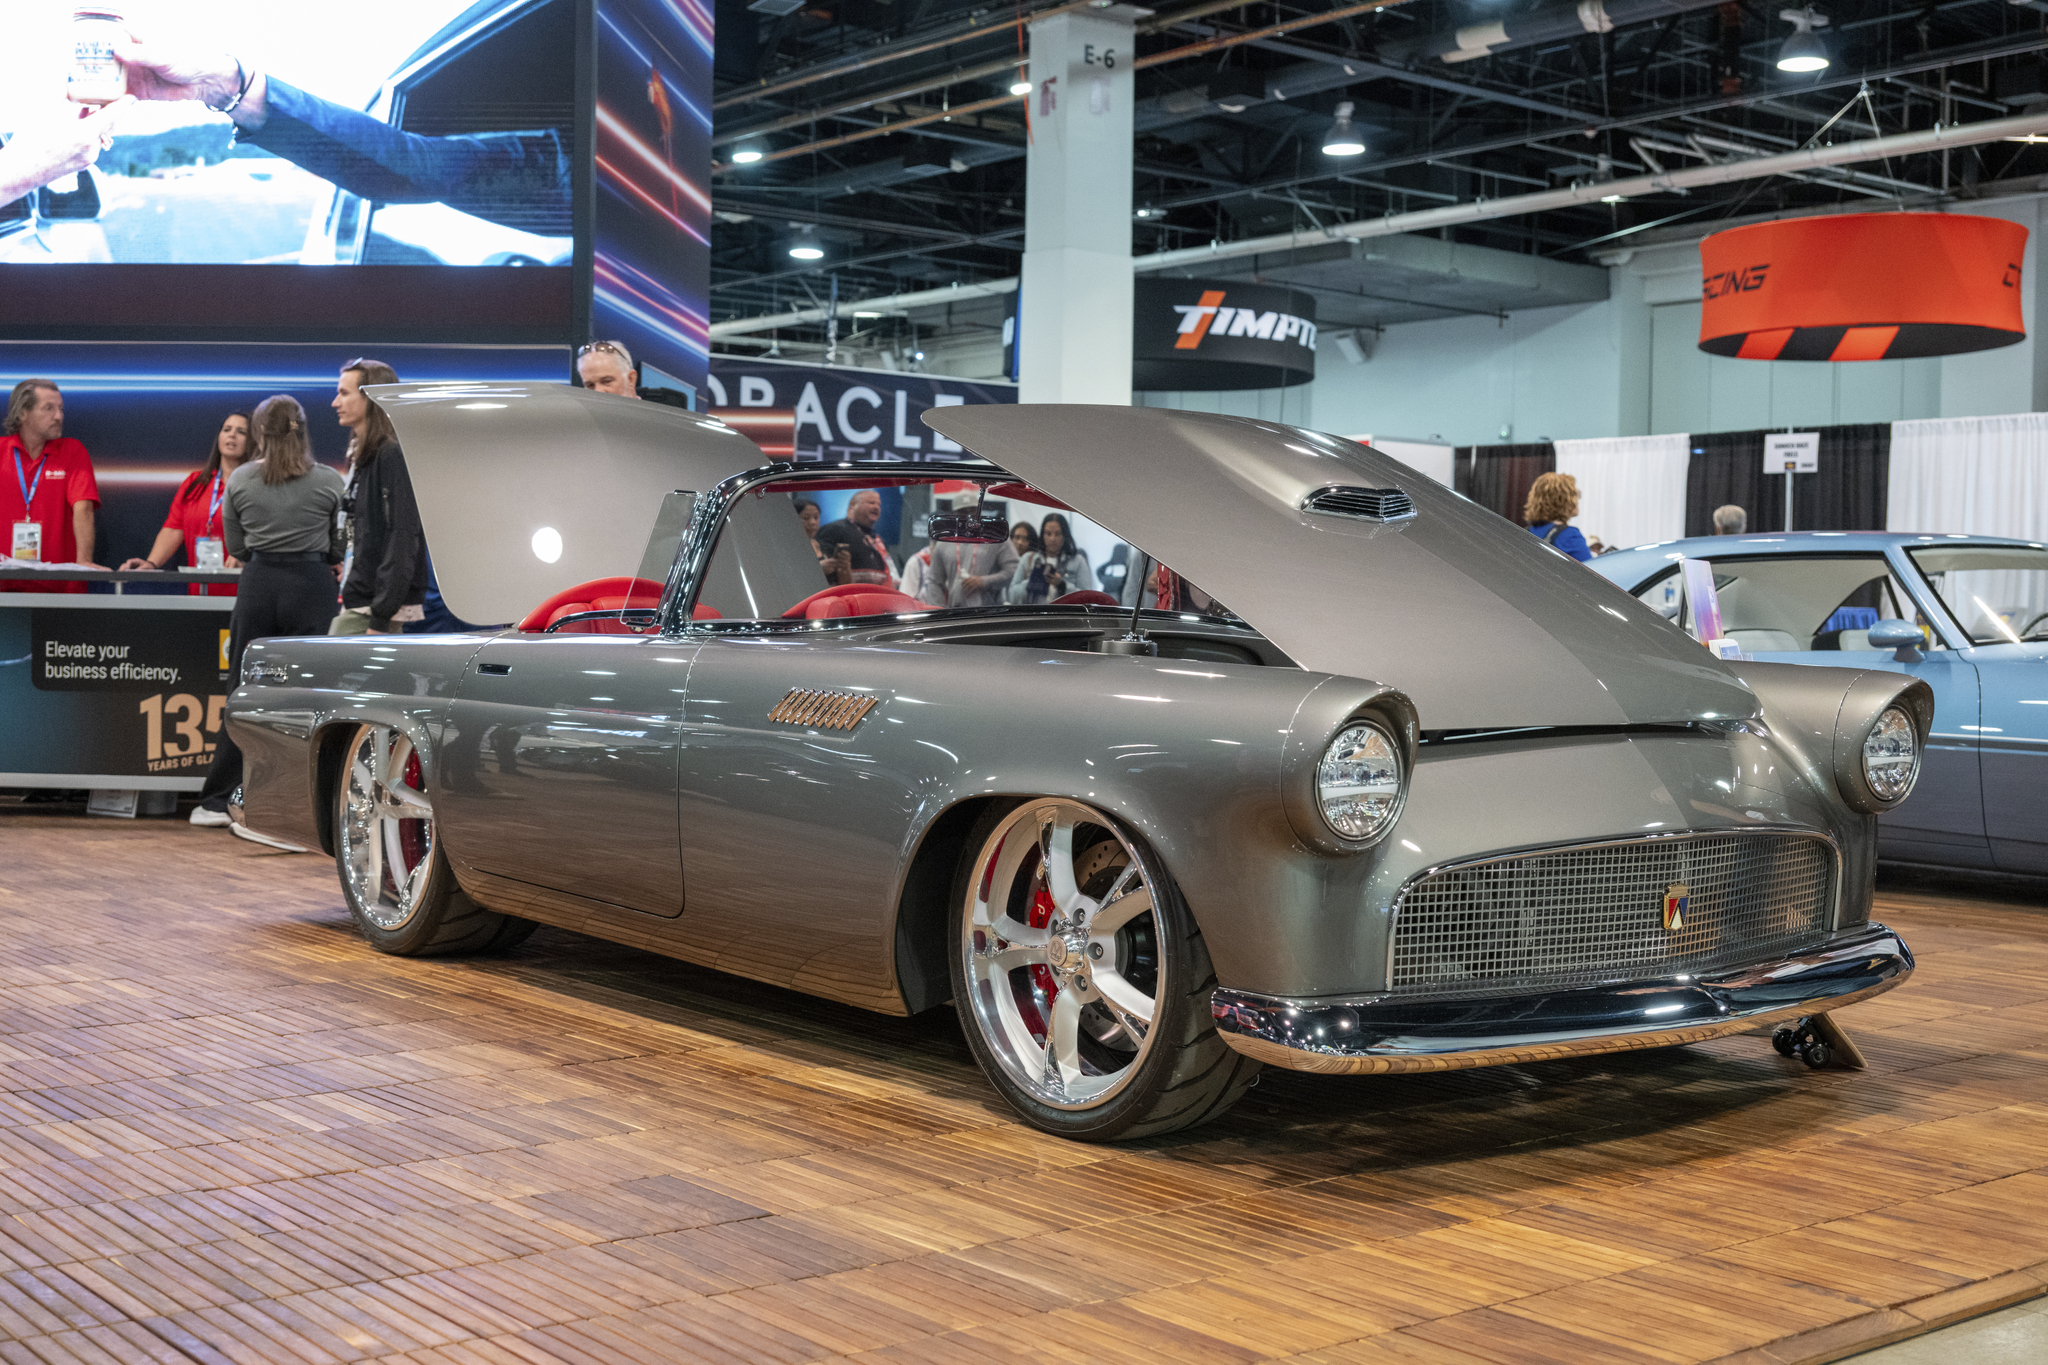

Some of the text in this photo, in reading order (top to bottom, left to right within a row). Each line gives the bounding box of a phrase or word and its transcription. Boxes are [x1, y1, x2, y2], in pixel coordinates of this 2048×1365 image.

[1084, 44, 1116, 69] E-6
[45, 640, 130, 662] Elevate your
[45, 662, 182, 685] business efficiency.
[147, 758, 179, 772] YEARS
[181, 755, 194, 767] OF
